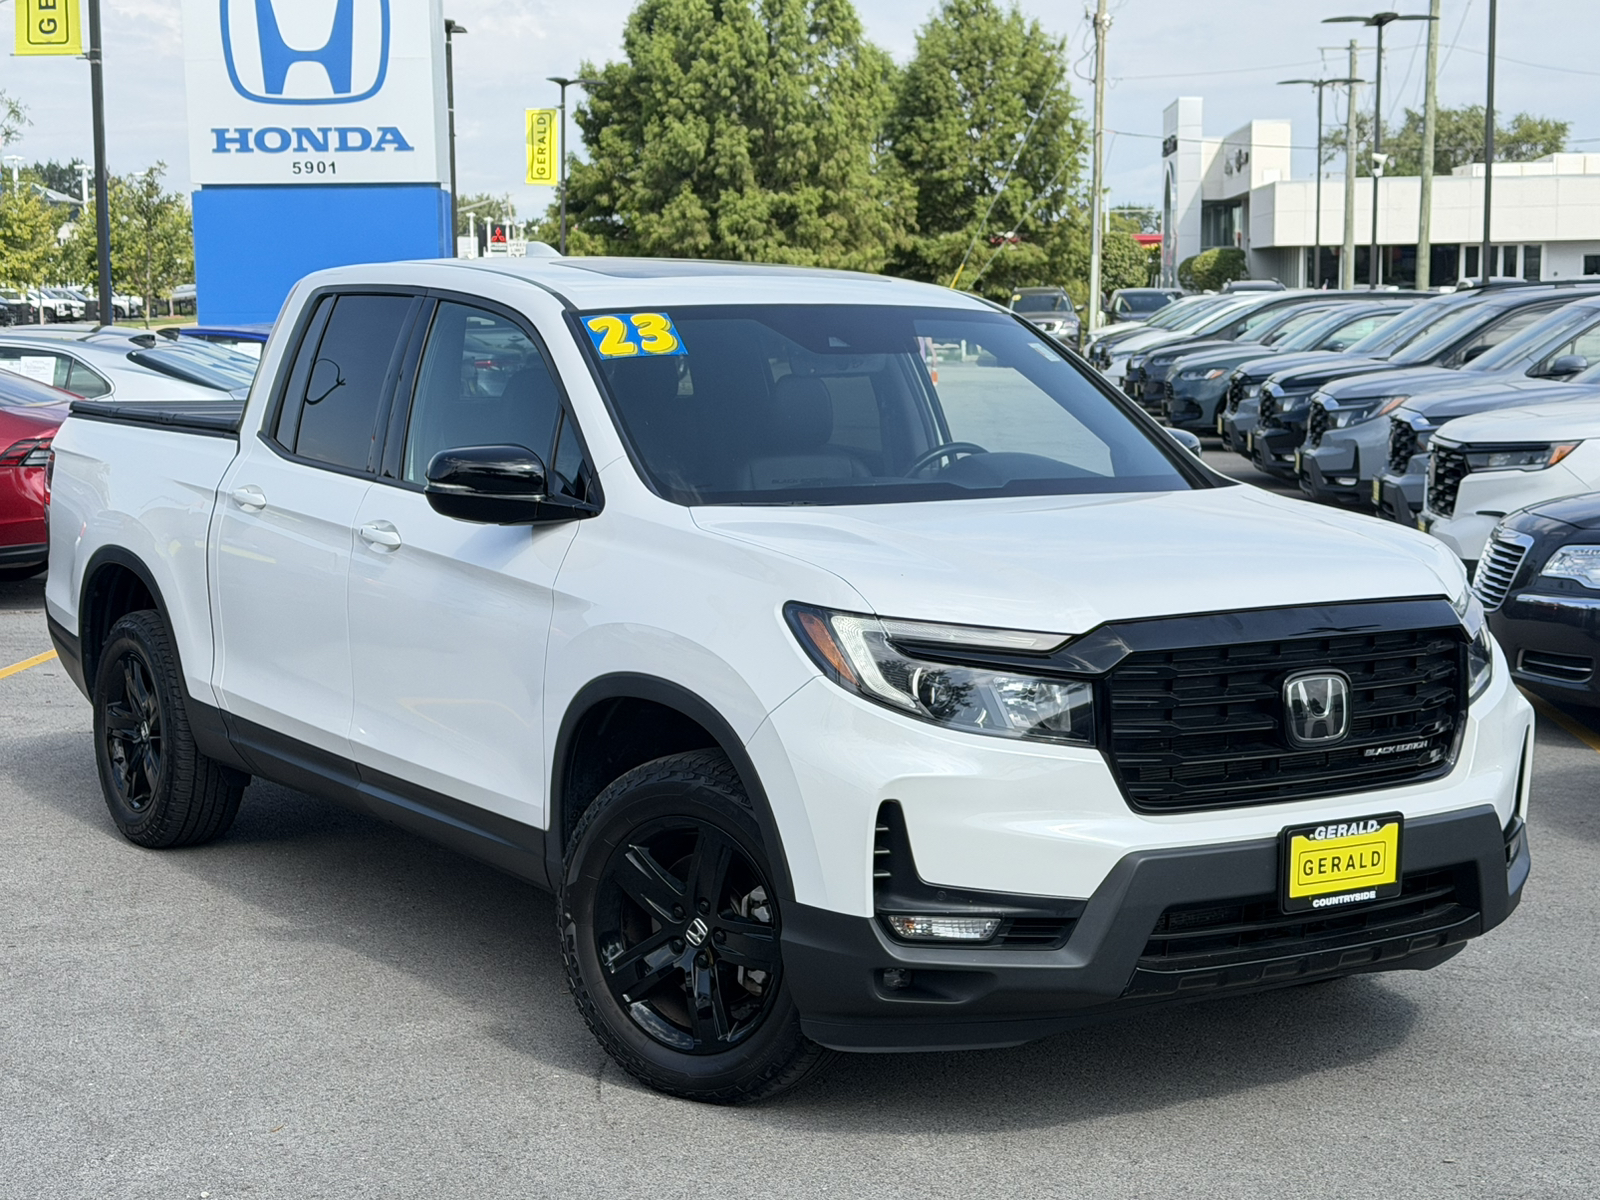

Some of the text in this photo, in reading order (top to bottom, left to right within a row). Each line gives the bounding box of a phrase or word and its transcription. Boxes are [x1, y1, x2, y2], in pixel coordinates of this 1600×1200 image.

[38, 0, 57, 34] GE
[210, 126, 415, 154] HONDA
[536, 116, 546, 175] GERALD
[292, 161, 337, 175] 5901
[587, 313, 678, 354] 23
[1364, 740, 1428, 757] BLACK EDITION
[1314, 820, 1378, 840] GERALD
[1303, 851, 1381, 876] GERALD
[1312, 890, 1377, 908] COUNTRYSIDE
